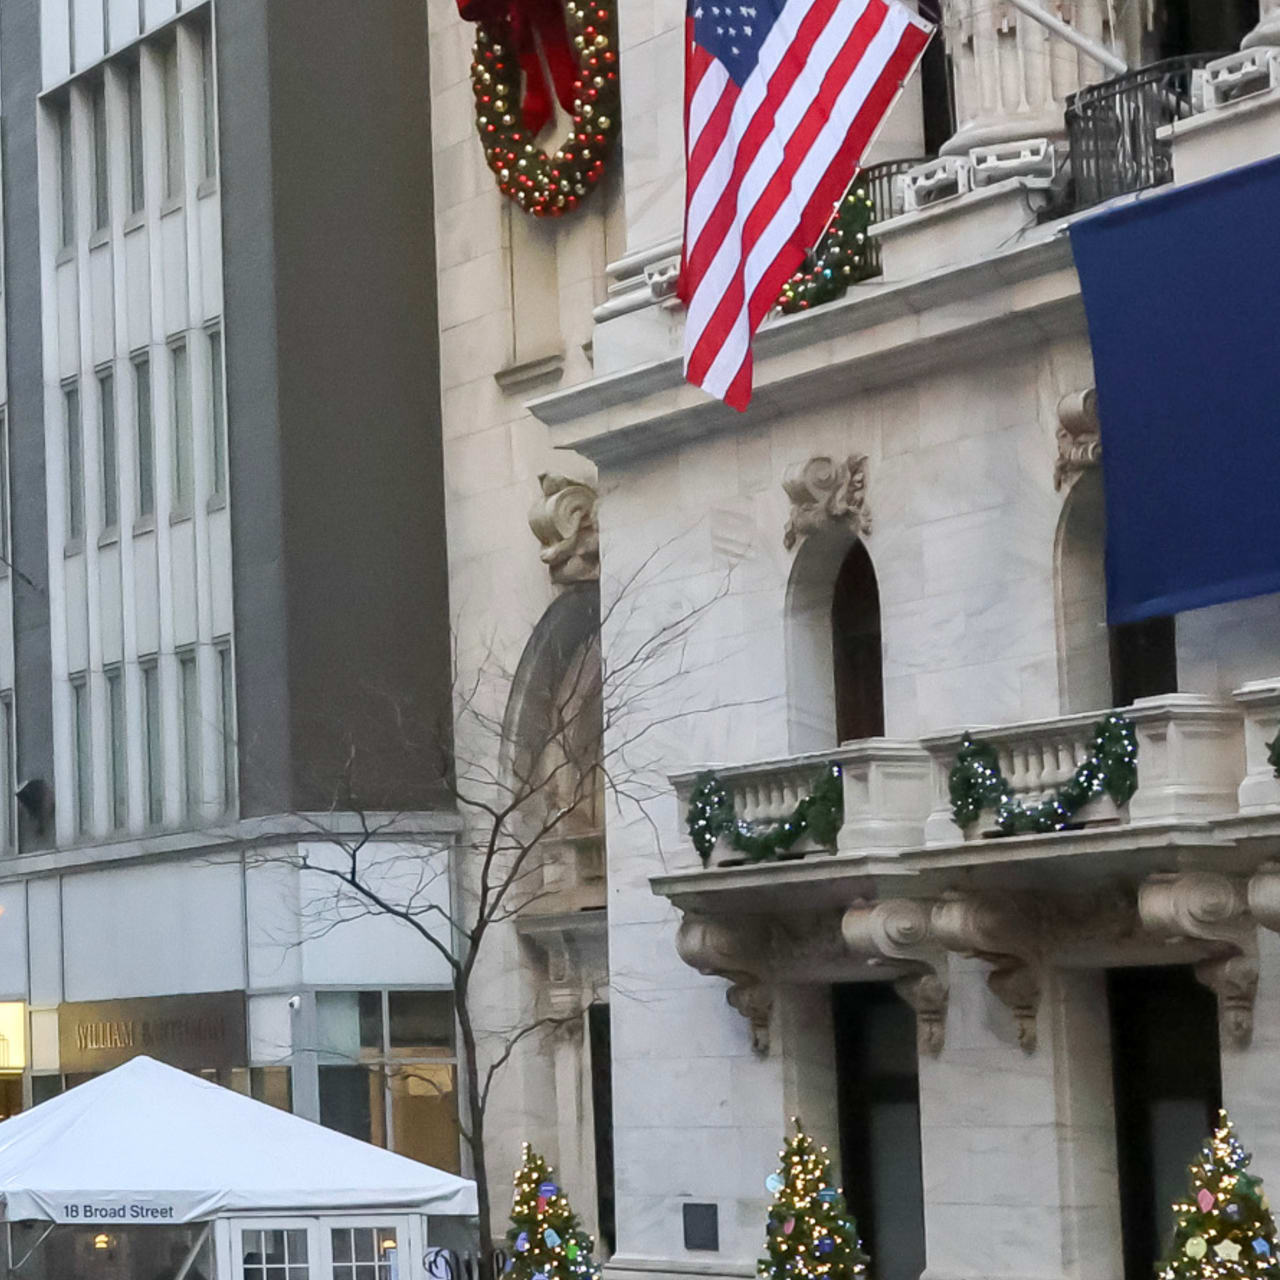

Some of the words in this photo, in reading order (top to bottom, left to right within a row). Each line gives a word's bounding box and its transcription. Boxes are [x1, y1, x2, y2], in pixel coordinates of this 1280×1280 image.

[75, 1021, 134, 1049] WILLIAM
[64, 1204, 80, 1218] 18
[83, 1204, 125, 1219] Broad
[128, 1204, 174, 1218] Street
